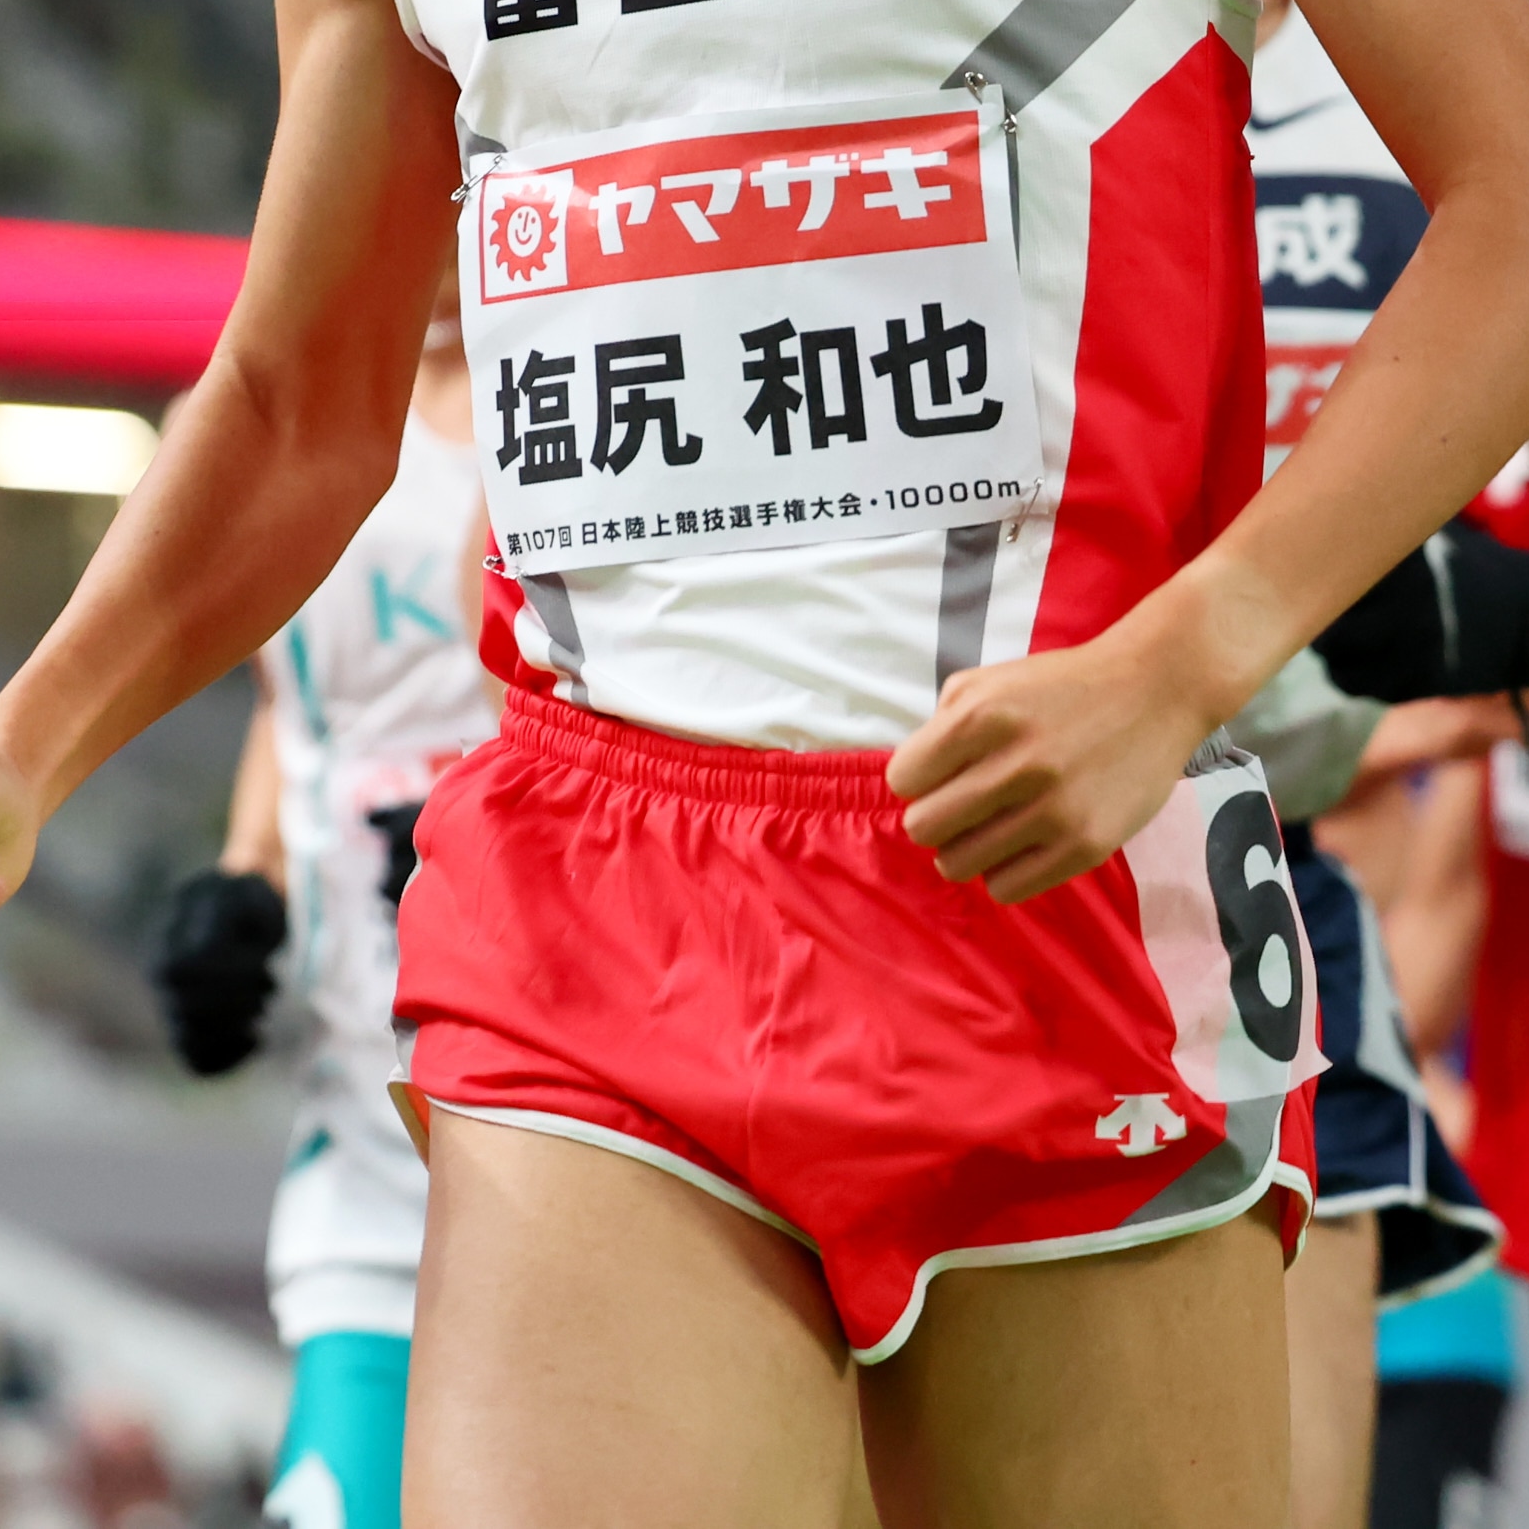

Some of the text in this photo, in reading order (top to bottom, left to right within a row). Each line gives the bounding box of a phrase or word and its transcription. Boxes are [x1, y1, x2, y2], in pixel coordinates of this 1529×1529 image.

[588, 147, 952, 255] ヤマザキ
[495, 302, 1004, 486] 塩尻 和也
[506, 524, 573, 557] 第107回
[1206, 791, 1303, 1062] 6
